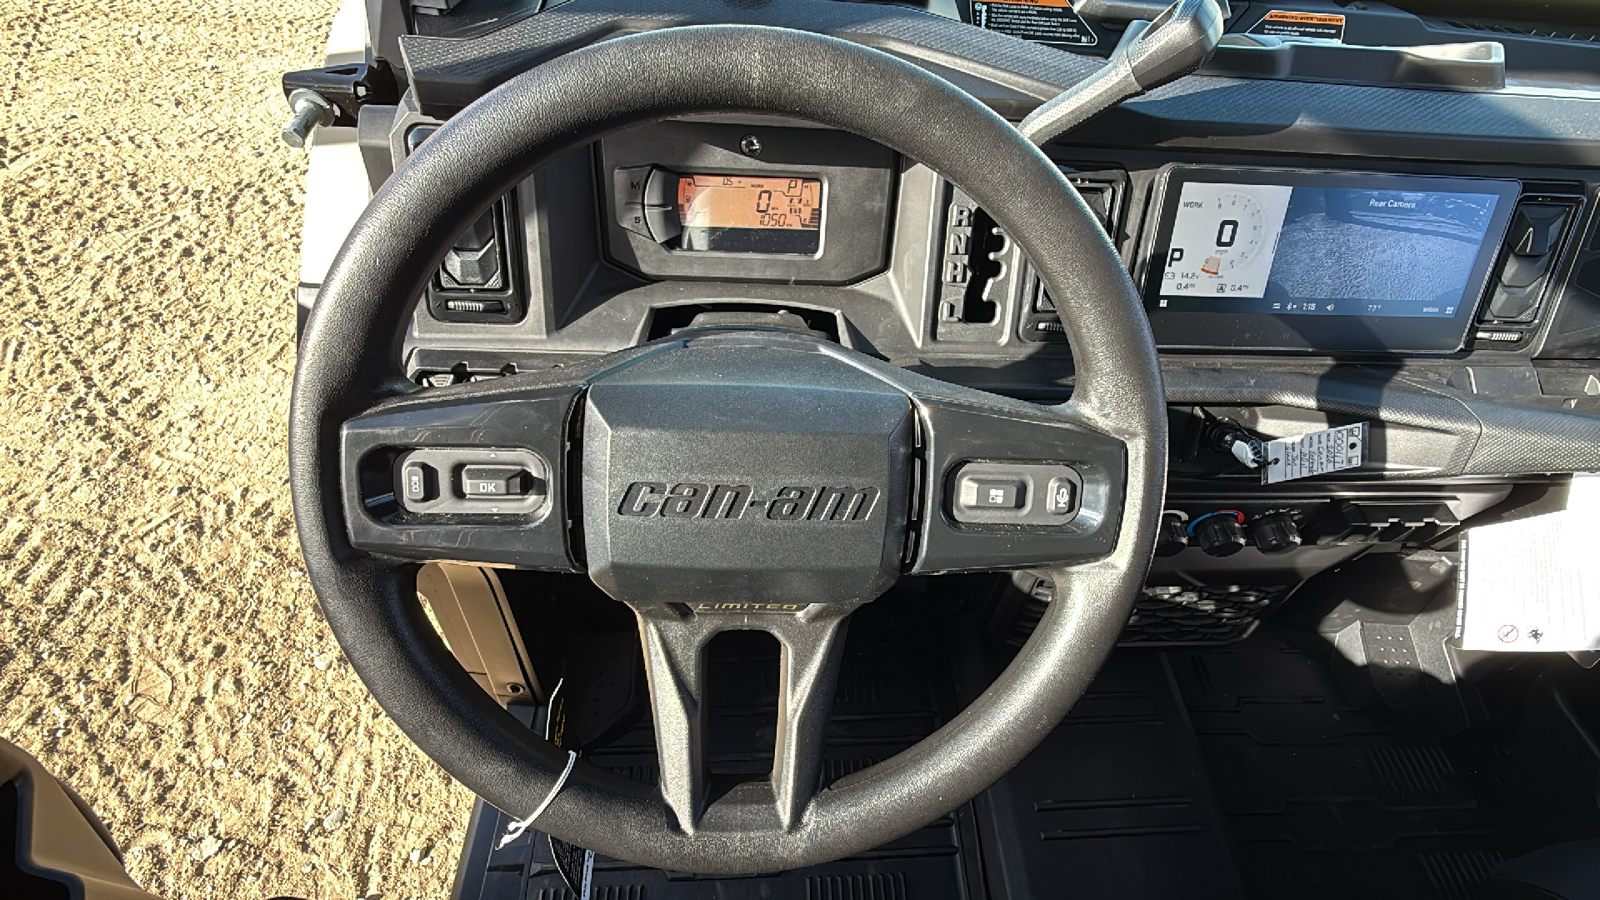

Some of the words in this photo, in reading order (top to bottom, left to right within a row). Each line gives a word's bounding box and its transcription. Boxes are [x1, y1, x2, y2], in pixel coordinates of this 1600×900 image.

[630, 181, 641, 190] M
[1369, 198, 1386, 207] Rear
[1388, 199, 1417, 209] Camera
[953, 204, 972, 227] R
[1215, 219, 1239, 247] 0
[951, 233, 969, 255] N
[1167, 247, 1184, 268] P
[479, 482, 496, 492] OK
[698, 602, 798, 611] LIMITED
